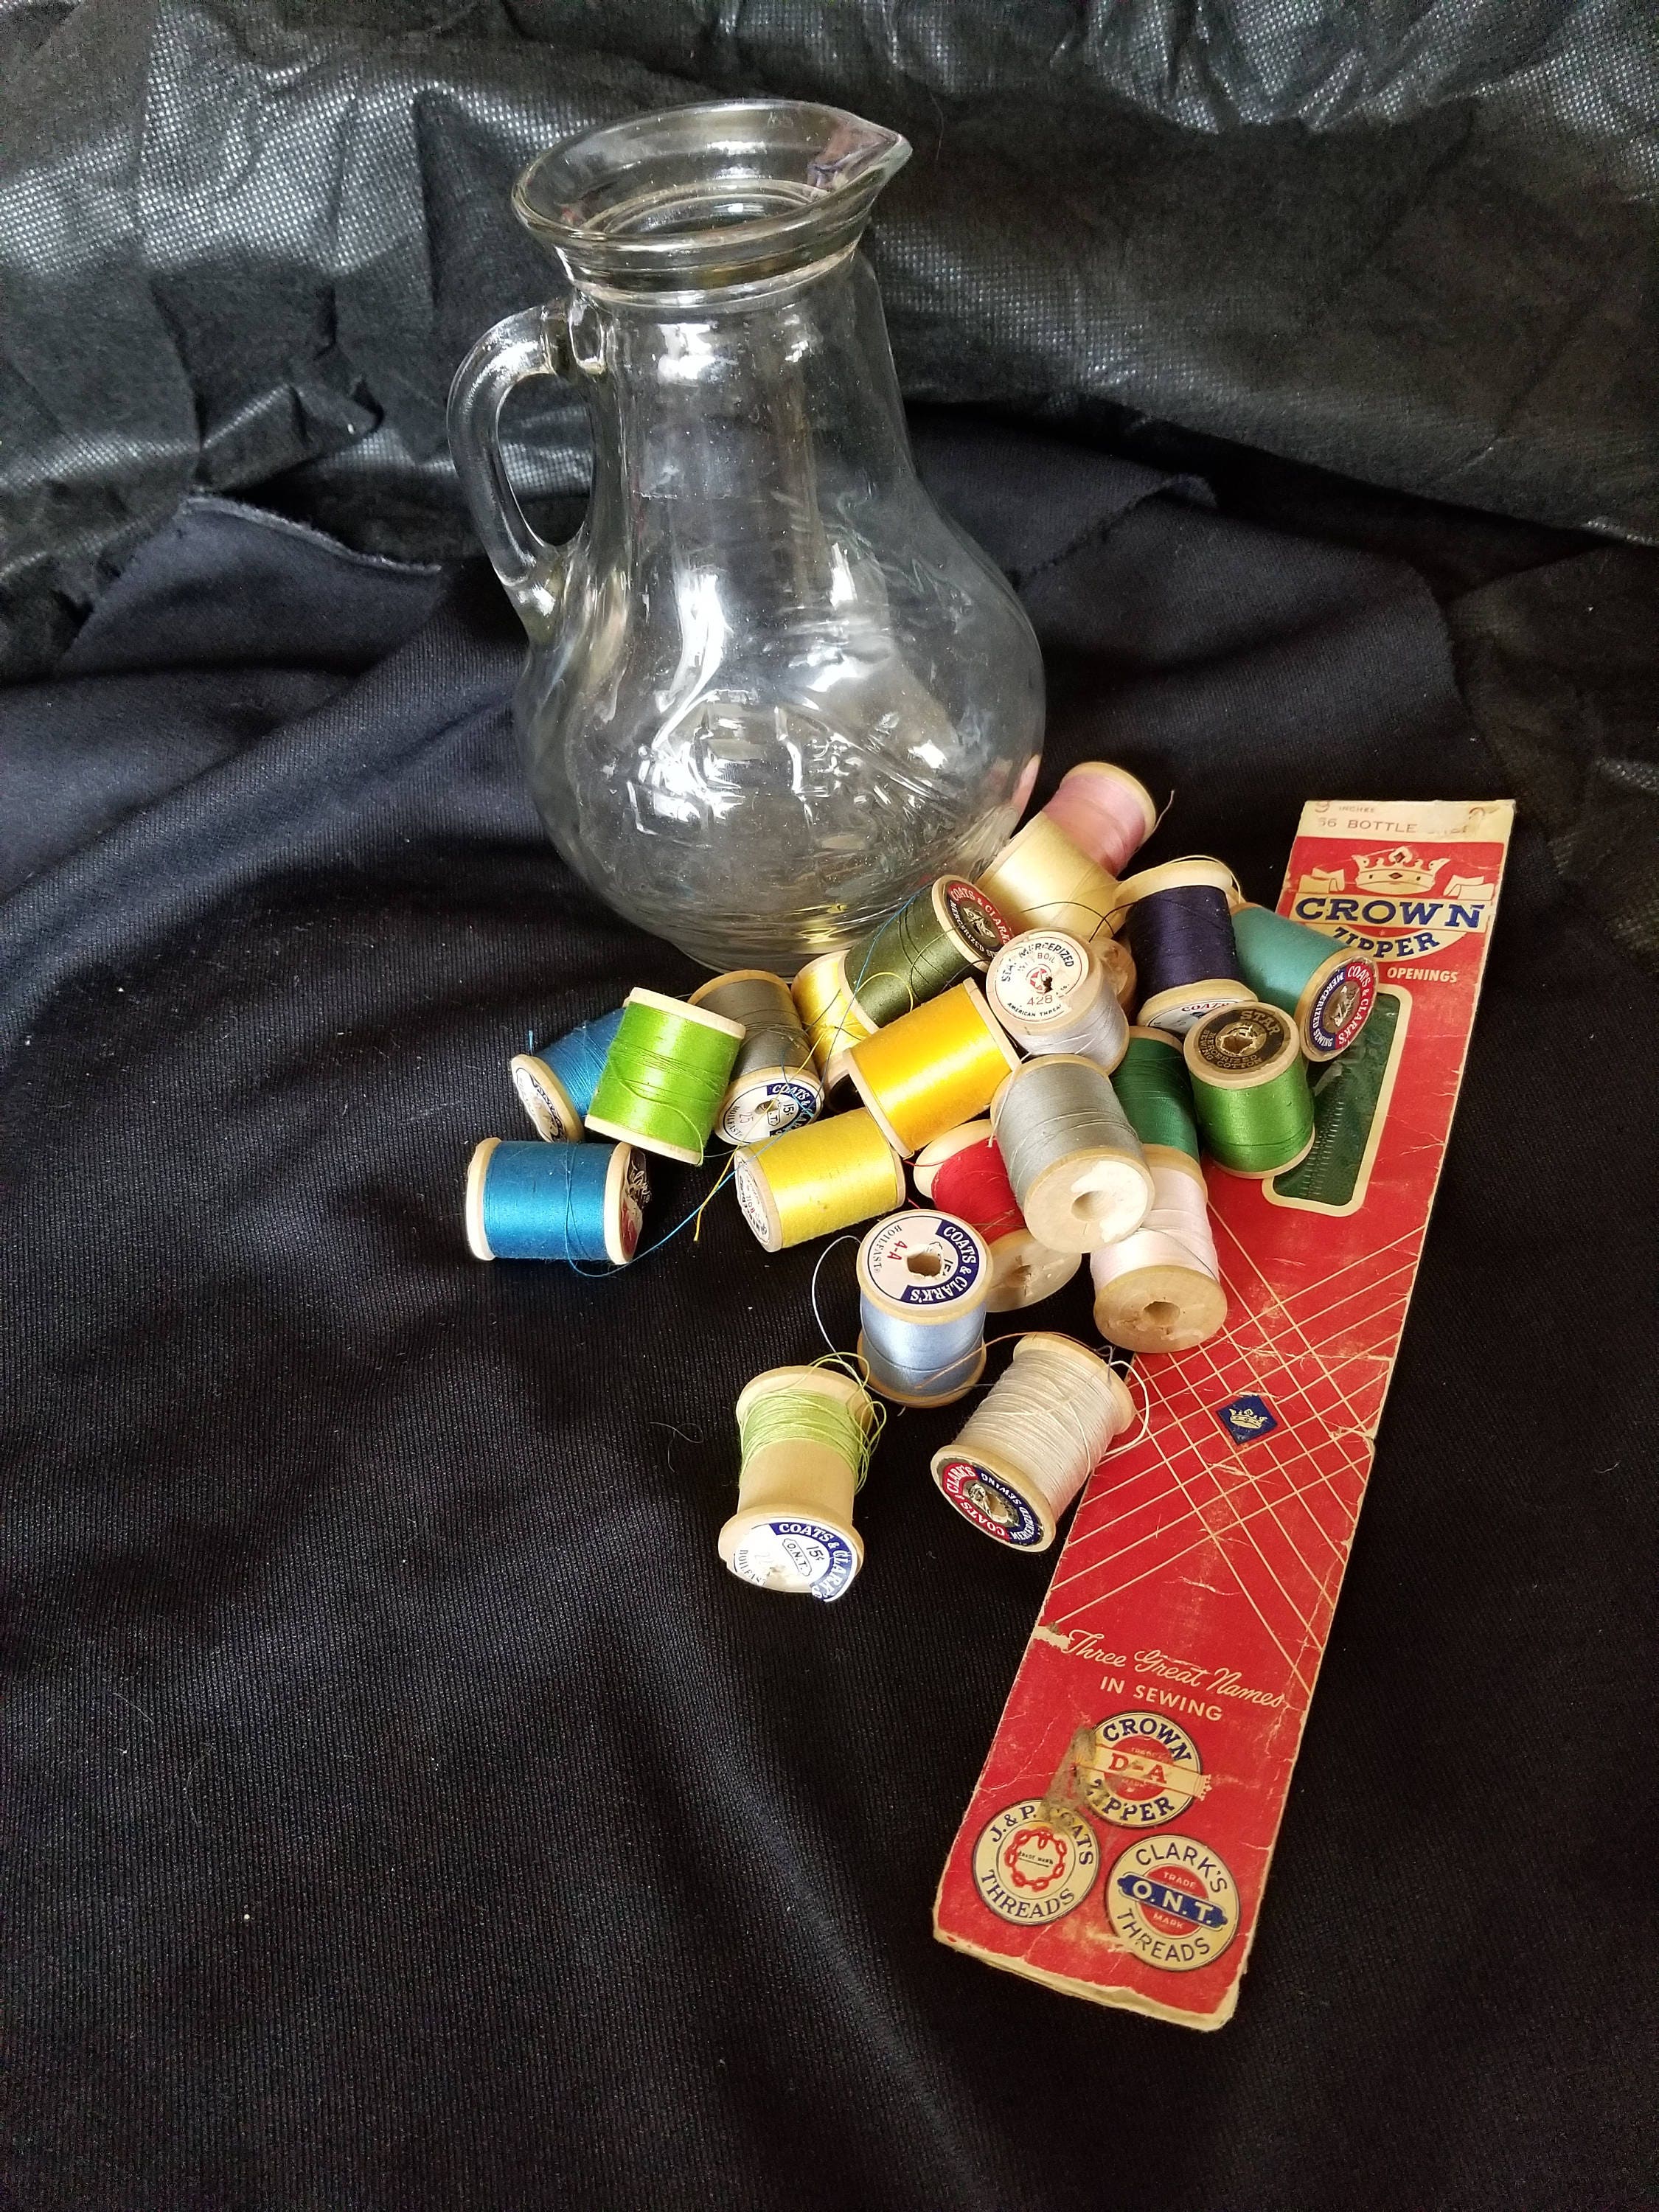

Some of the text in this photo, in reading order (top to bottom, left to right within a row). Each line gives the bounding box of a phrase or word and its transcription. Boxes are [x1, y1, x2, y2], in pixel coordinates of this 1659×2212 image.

[1348, 819, 1419, 834] BOTTLE
[950, 887, 975, 901] COATS
[950, 899, 984, 953] MERCERIZED
[1295, 897, 1485, 928] CROWN
[1386, 967, 1458, 984] OPENINGS
[1007, 1002, 1062, 1017] AMERICAN THREA
[1026, 995, 1054, 1006] 428
[1312, 971, 1345, 1048] MERCERIZED SEWING
[1338, 965, 1371, 1046] COATS & CLARK'S
[1239, 1010, 1281, 1036] STAR
[910, 1225, 977, 1304] COATS & CLARK'S
[946, 1464, 976, 1494] CLARK'S
[981, 1472, 1022, 1506] SEWING
[960, 1501, 1006, 1537] COATS
[779, 1523, 834, 1543] COATS
[827, 1540, 841, 1550] &
[787, 1543, 808, 1571] O.N.T.
[806, 1545, 826, 1562] 15¢
[1061, 1629, 1285, 1708] Three Great Names
[1099, 1676, 1223, 1722] IN SEWING
[1102, 1717, 1193, 1763] CROWN
[1108, 1753, 1168, 1785] D-A
[1135, 1842, 1228, 1894] CLARK'S
[1163, 1871, 1197, 1890] TRADE
[980, 1869, 1076, 1919] THREADS
[1116, 1907, 1211, 1963] THREADS
[1152, 1913, 1185, 1930] MARK
